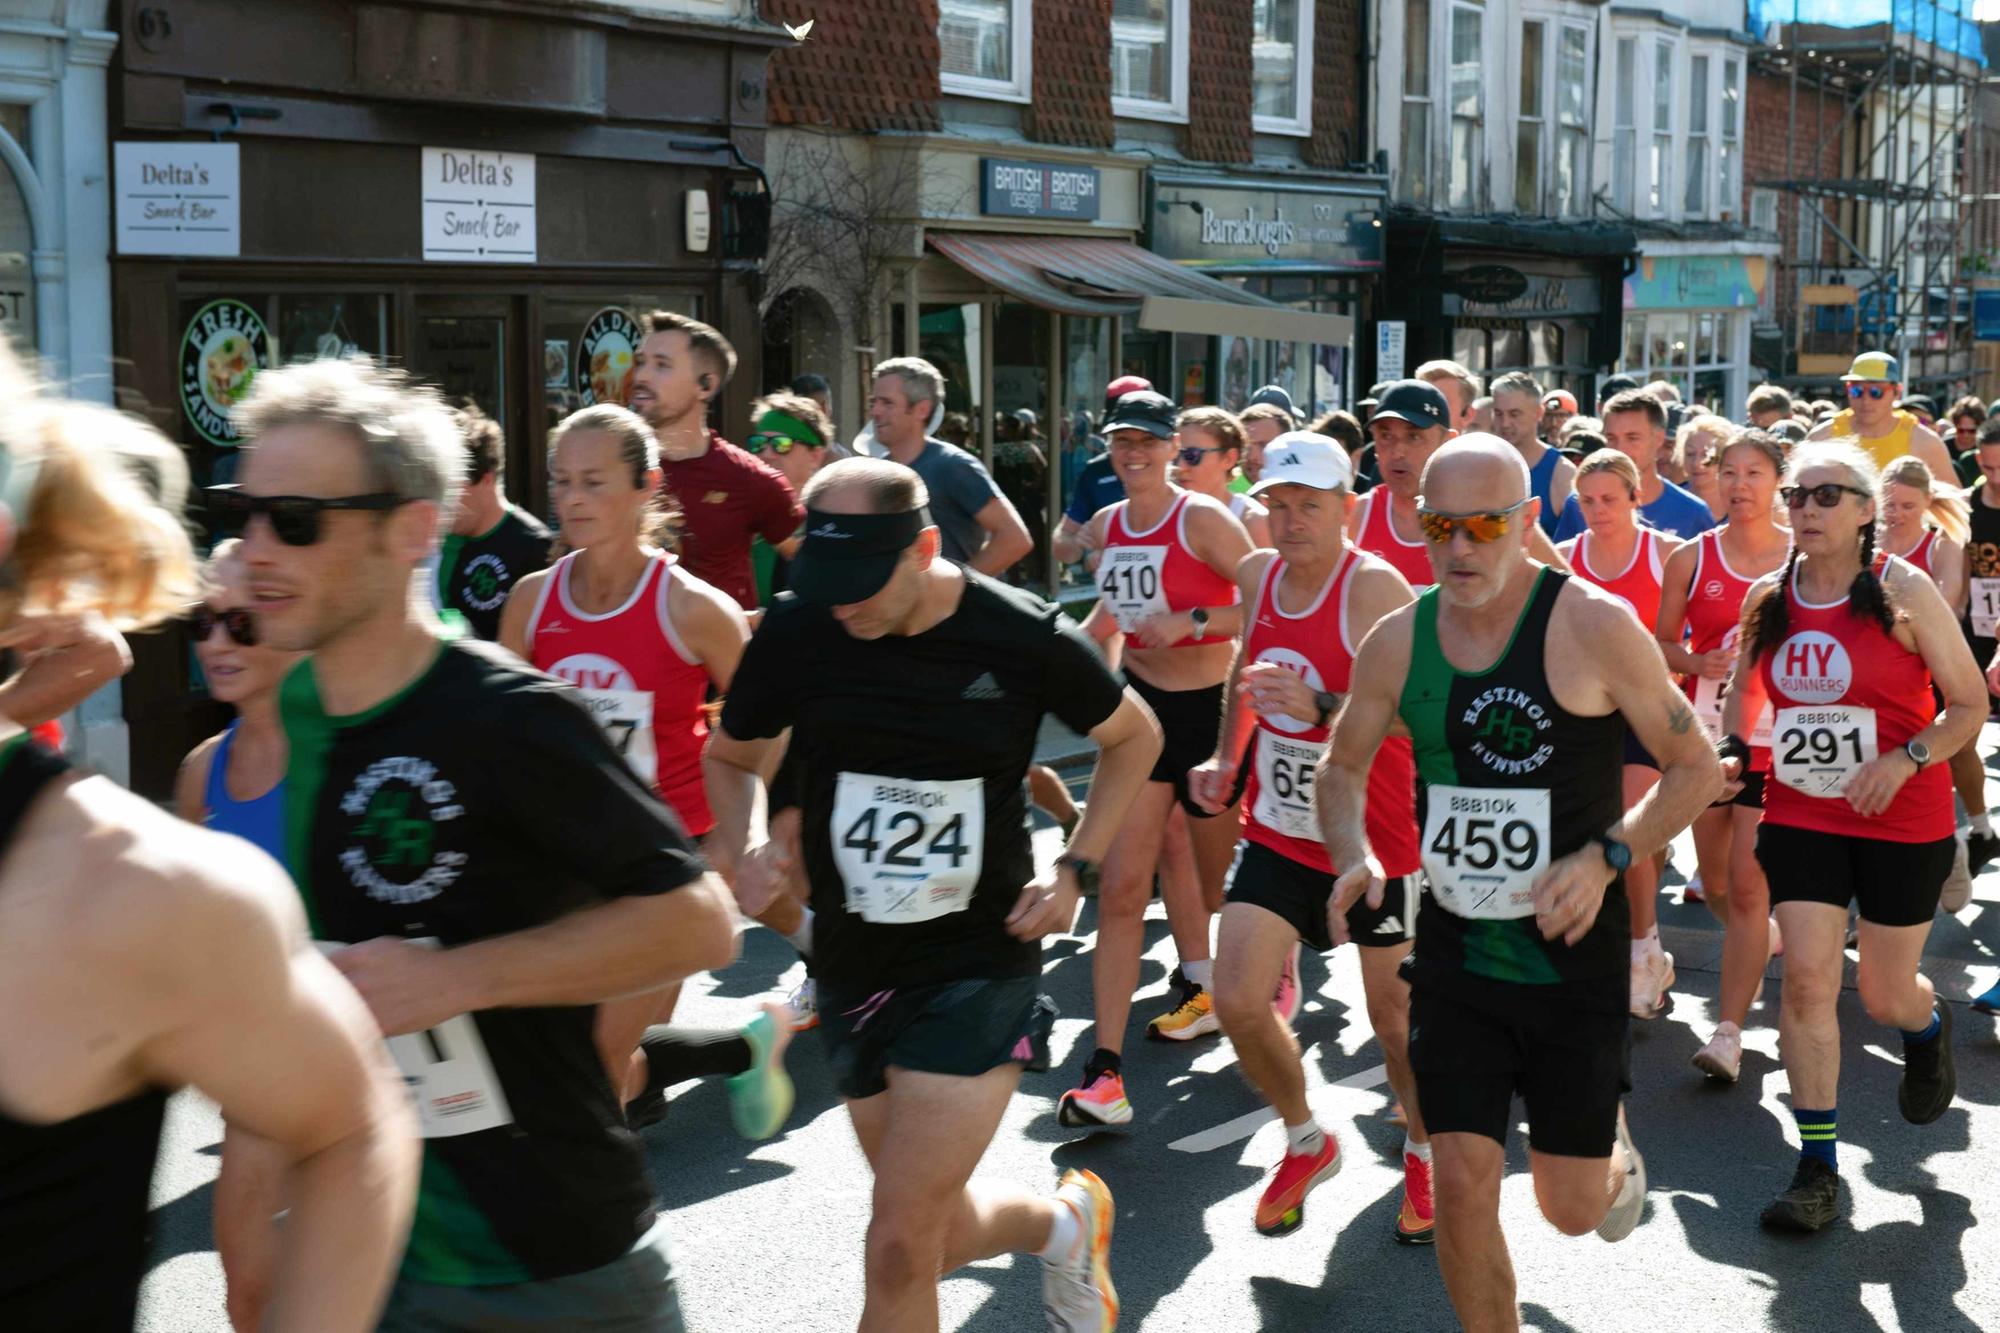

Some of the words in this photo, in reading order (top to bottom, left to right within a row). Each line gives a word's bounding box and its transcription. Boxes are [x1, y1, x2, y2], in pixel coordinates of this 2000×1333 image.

[142, 162, 210, 186] Delta's
[442, 152, 514, 188] Delta's
[995, 166, 1042, 191] BRITISH
[1051, 171, 1095, 196] BRITISH
[144, 201, 186, 221] Snack
[190, 202, 217, 221] Bar
[443, 210, 489, 239] Snack
[493, 213, 520, 239] Bar
[1202, 207, 1293, 256] Barracloughs
[189, 305, 261, 350] FRESH
[184, 381, 237, 439] SANDW
[1102, 564, 1156, 600] 410
[1785, 643, 1836, 678] HY
[1779, 677, 1846, 693] RUNNERS
[1462, 686, 1553, 731] HASTINGS
[1796, 713, 1851, 725] BBB10k
[1470, 741, 1554, 775] RUNNERS
[1780, 727, 1864, 766] 291
[1449, 796, 1518, 815] BBB10k
[842, 806, 970, 869] 424
[1430, 816, 1540, 873] 459
